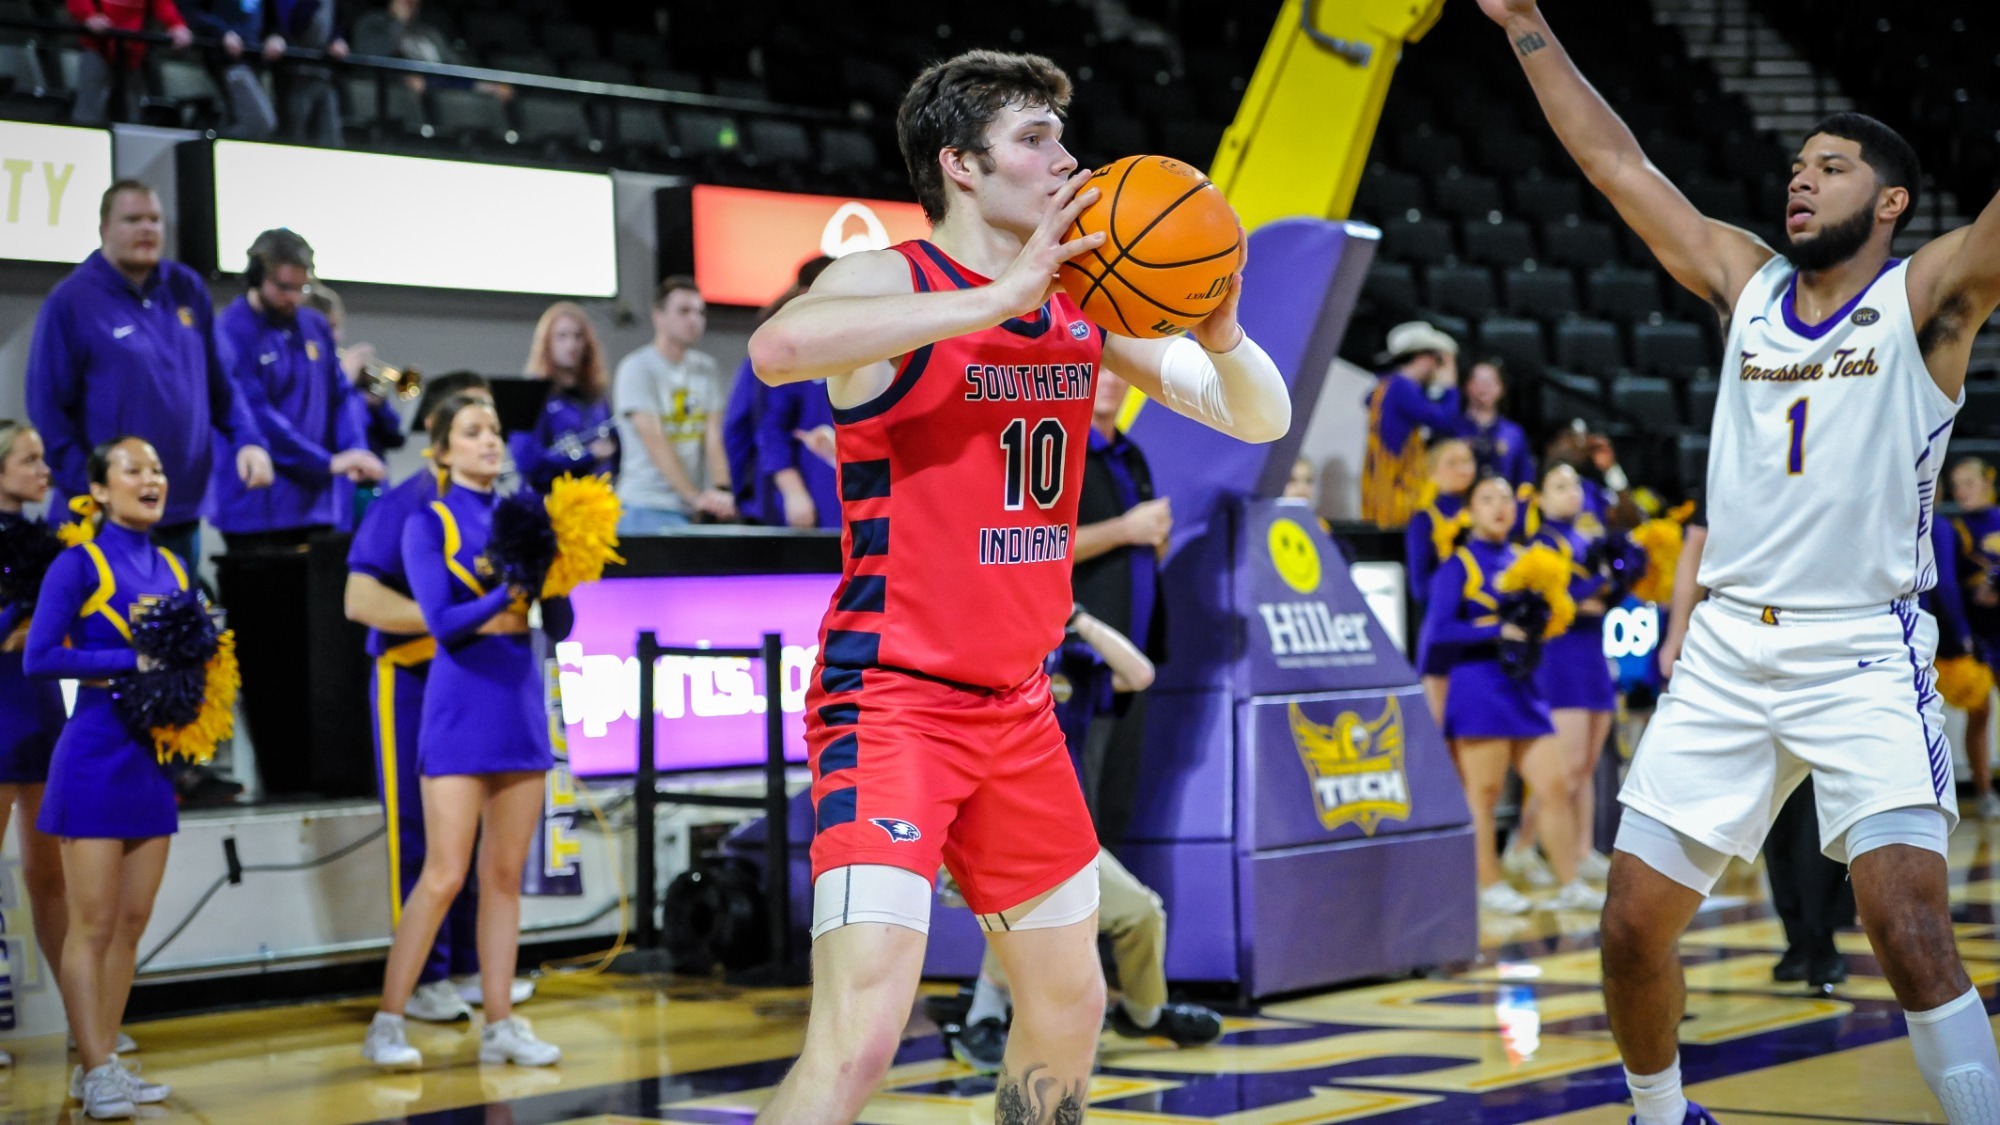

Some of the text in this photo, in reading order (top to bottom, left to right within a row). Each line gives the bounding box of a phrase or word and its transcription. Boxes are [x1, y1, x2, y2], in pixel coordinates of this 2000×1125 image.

[2, 158, 76, 226] TY
[965, 362, 1093, 401] SOUTHERN
[1828, 347, 1879, 379] Tech
[1785, 395, 1810, 476] 1
[1000, 417, 1068, 511] 10
[979, 523, 1070, 565] INDIANA
[1258, 600, 1373, 655] Hiller
[1315, 769, 1408, 811] TECH
